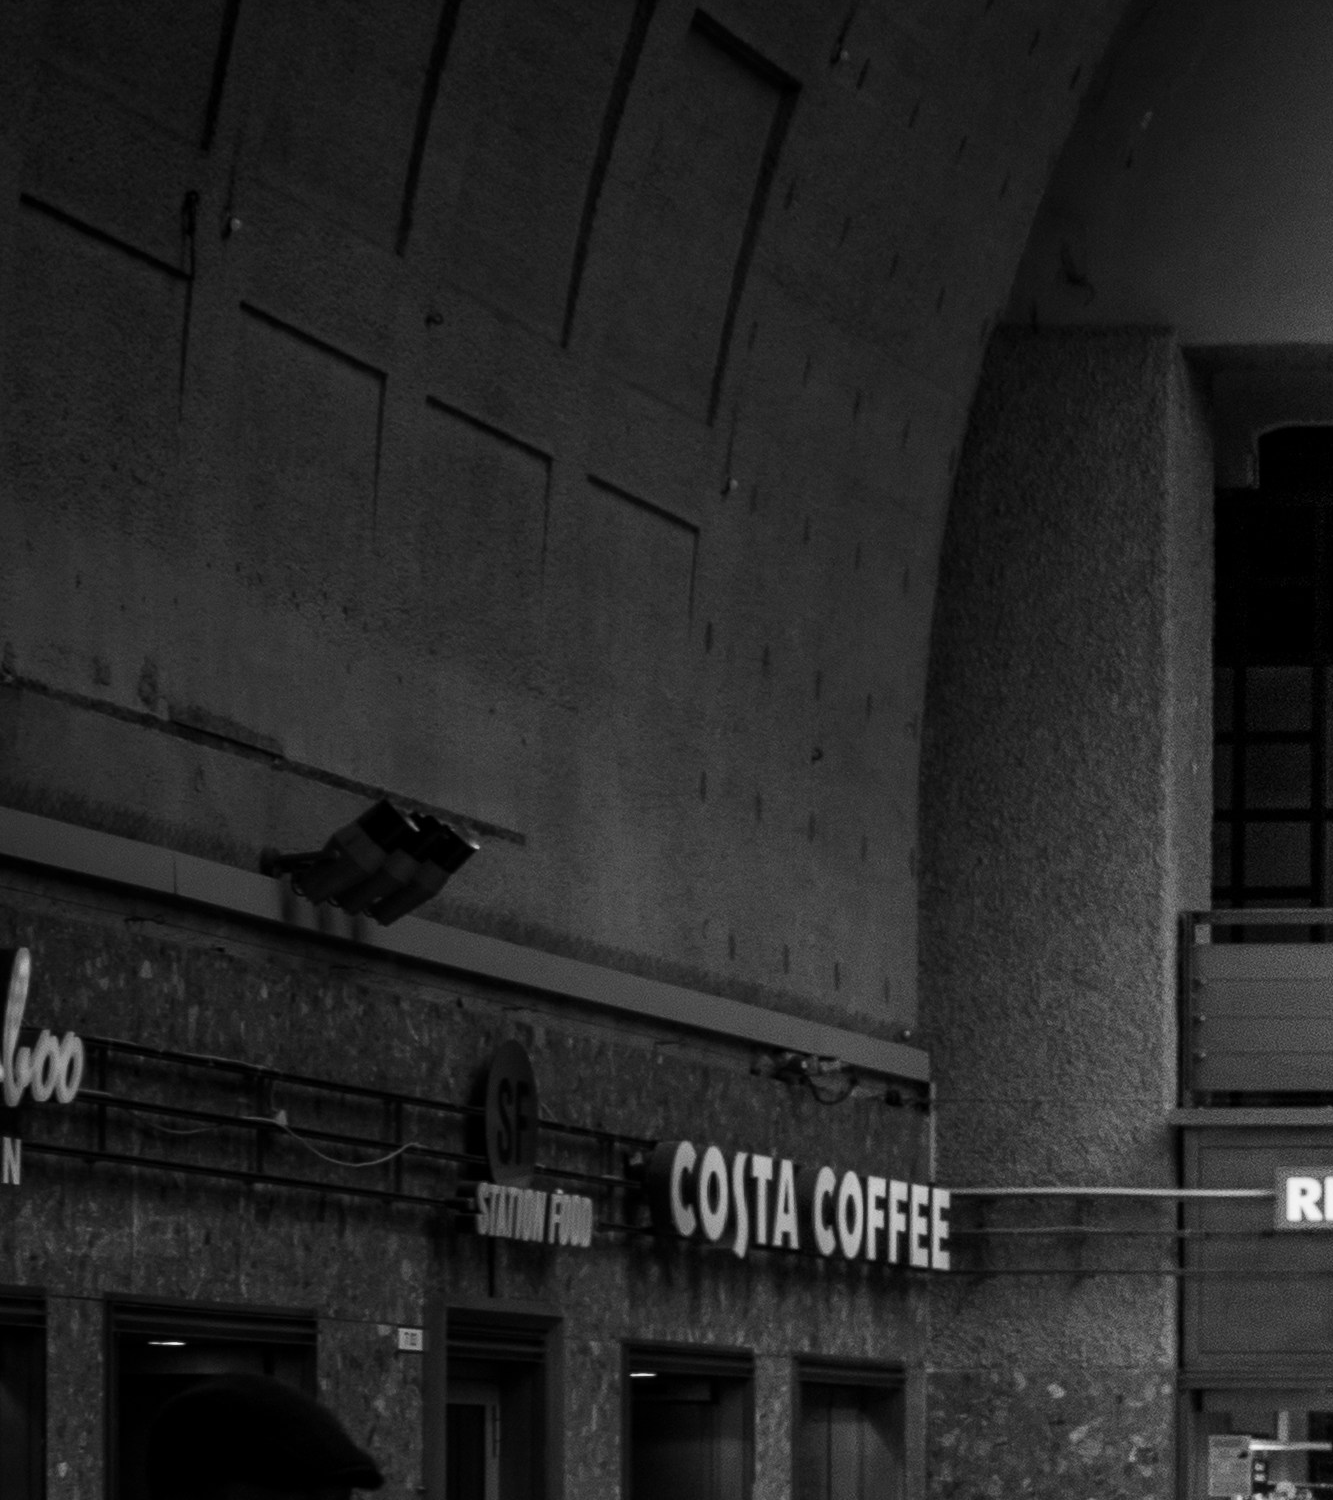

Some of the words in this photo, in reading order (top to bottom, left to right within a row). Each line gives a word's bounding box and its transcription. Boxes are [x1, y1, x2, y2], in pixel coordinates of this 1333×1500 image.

[497, 1077, 529, 1165] SF
[477, 1184, 547, 1244] STATION
[547, 1190, 593, 1247] FOOD
[670, 1140, 799, 1258] COSTA
[813, 1166, 952, 1271] COFFEE
